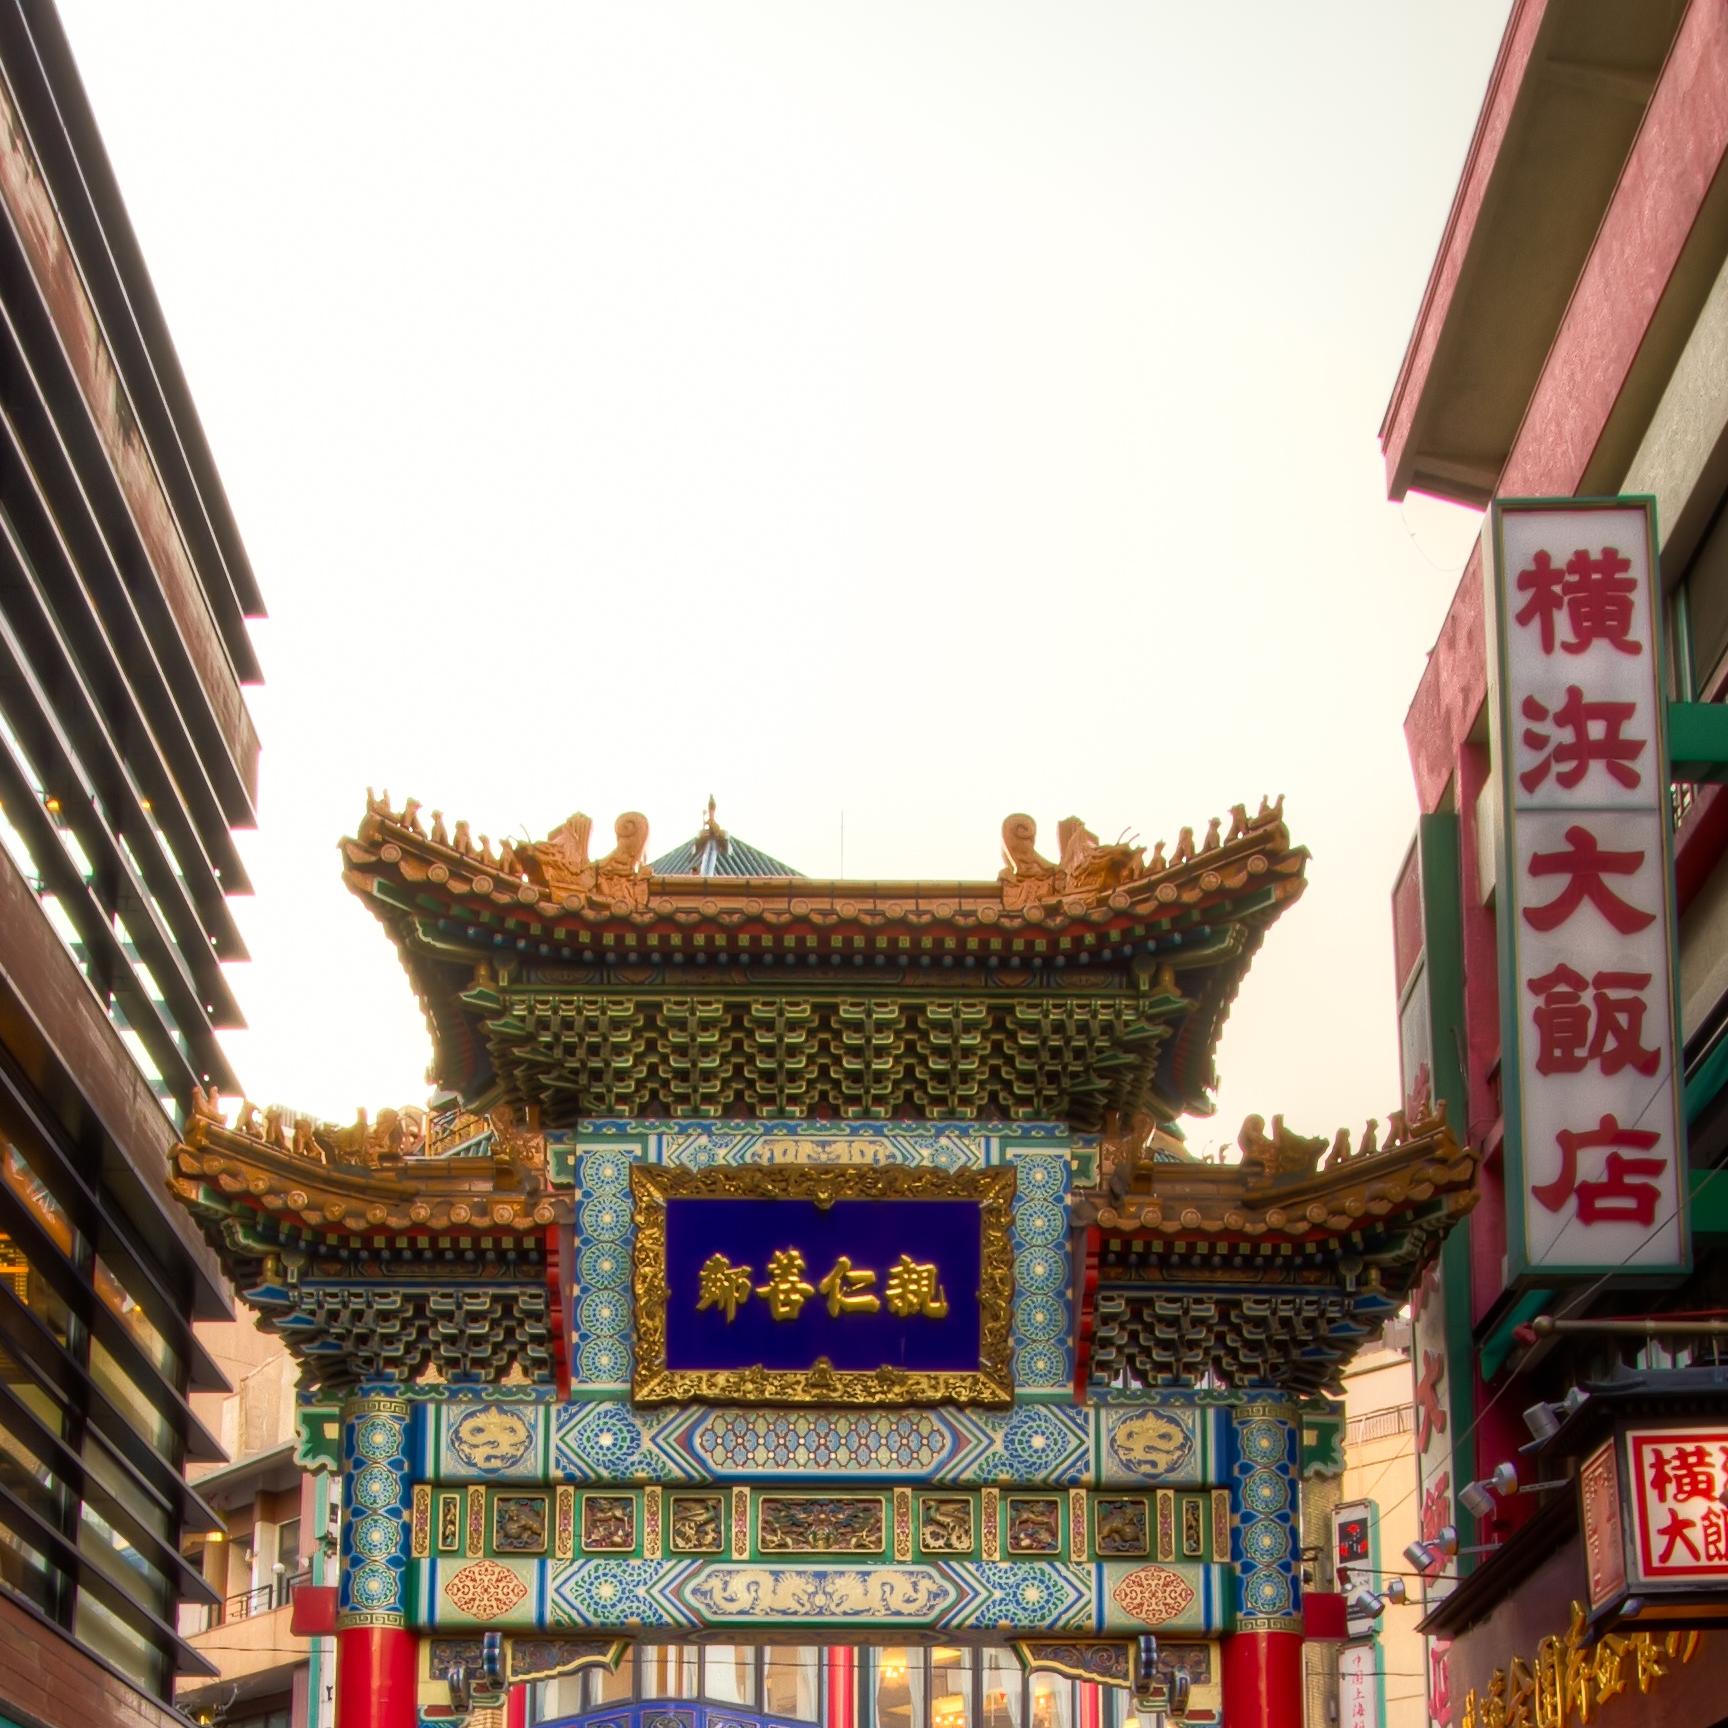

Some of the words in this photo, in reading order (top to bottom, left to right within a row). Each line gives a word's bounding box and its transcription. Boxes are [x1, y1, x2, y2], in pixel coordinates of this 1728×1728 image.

[1513, 546, 1665, 1229] 横浜大飯店
